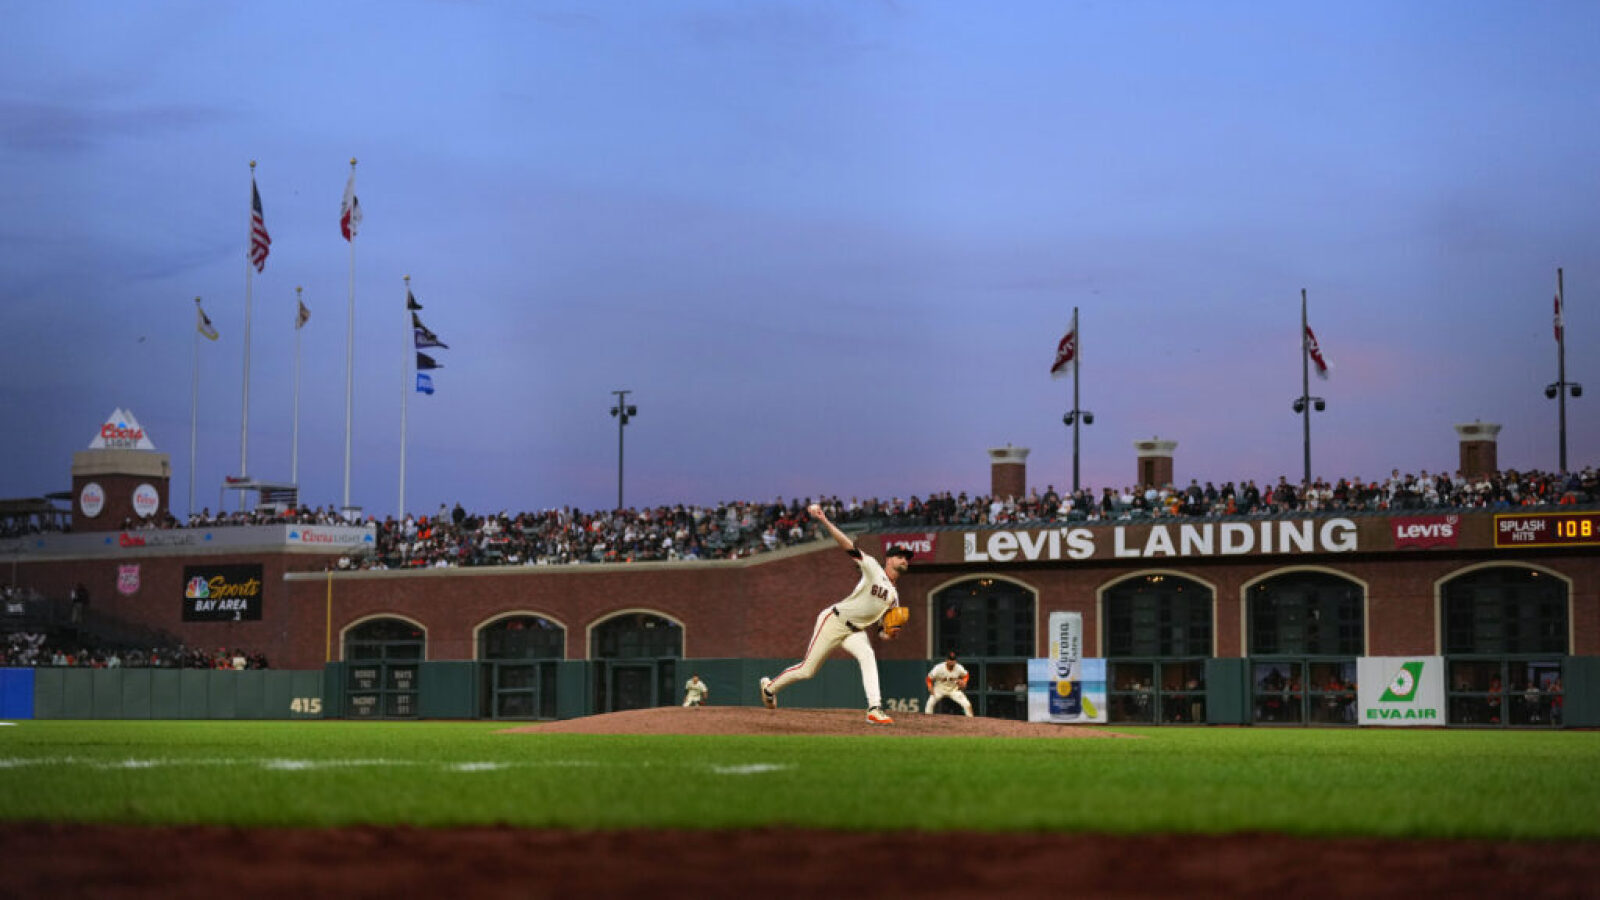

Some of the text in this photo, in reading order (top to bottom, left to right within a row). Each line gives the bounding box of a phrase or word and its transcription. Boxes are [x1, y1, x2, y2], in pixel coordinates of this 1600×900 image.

[1500, 519, 1546, 532] SPLASH
[1557, 520, 1592, 537] 108
[1113, 517, 1358, 558] LANDING
[1511, 531, 1536, 541] HITS
[208, 576, 260, 598] Sports
[195, 599, 248, 611] BAY AREA
[1056, 622, 1071, 679] Corona
[290, 697, 322, 714] 415
[886, 698, 920, 713] 365
[1366, 708, 1437, 720] EVA AIR
